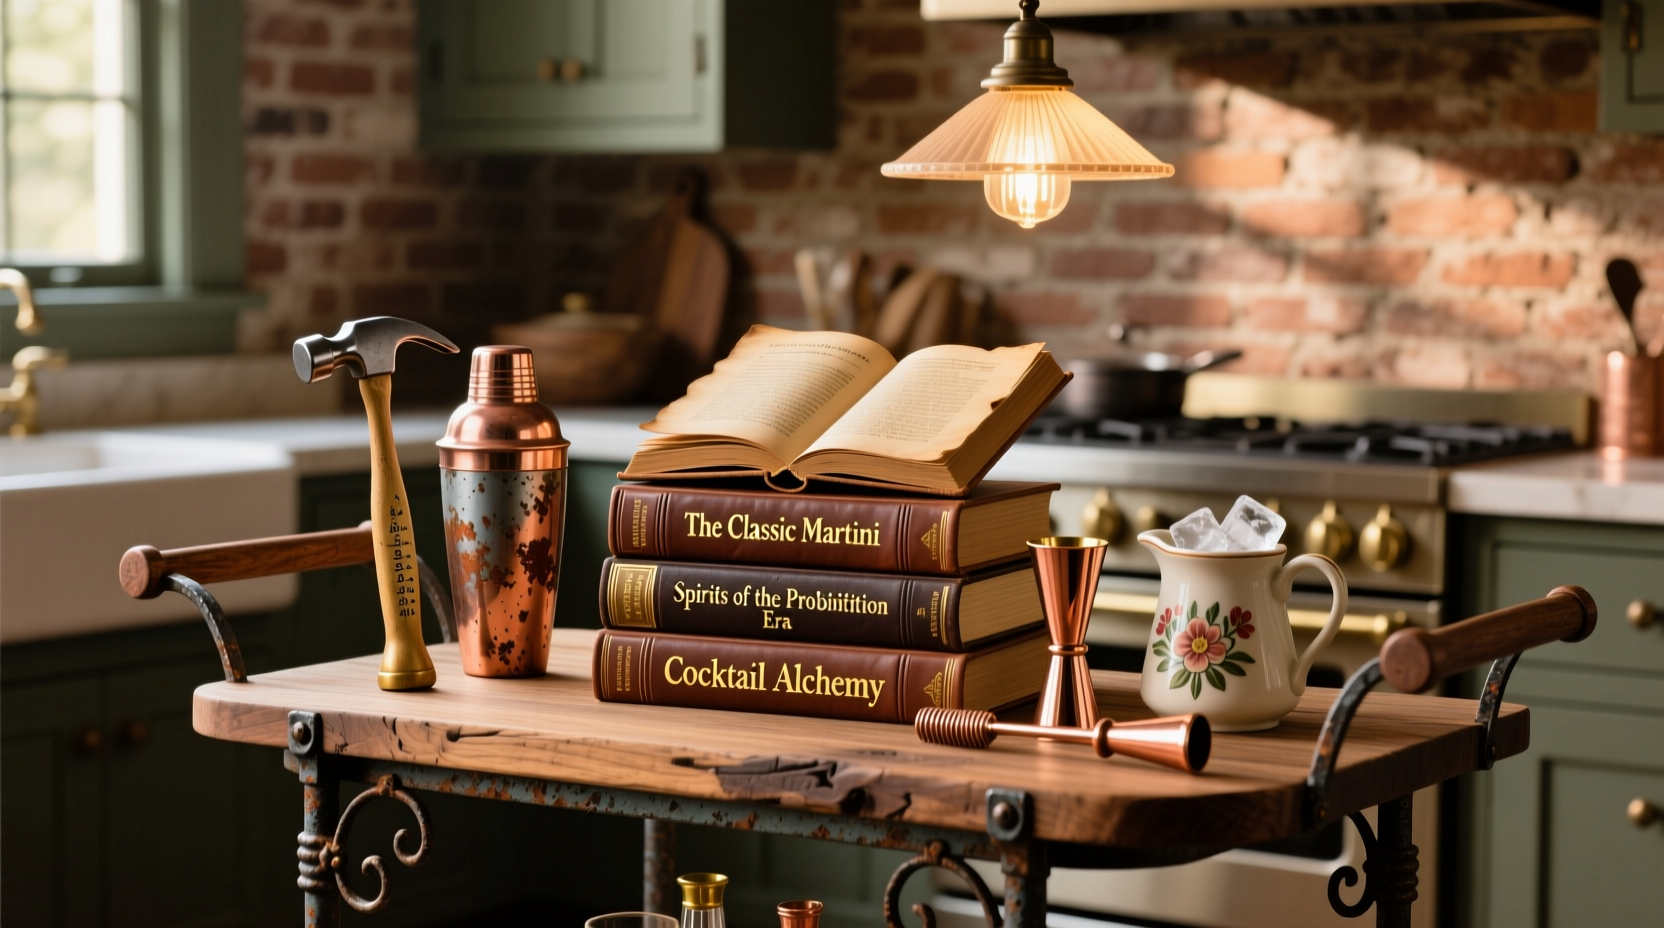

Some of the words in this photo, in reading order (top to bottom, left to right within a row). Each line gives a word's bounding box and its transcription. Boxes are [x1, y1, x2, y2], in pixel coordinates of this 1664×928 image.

[683, 511, 723, 539] The
[727, 513, 797, 542] Classic
[801, 516, 881, 547] Martini
[673, 580, 729, 611] Spirits
[732, 585, 752, 607] of
[755, 586, 782, 608] the
[762, 609, 792, 629] Era
[664, 655, 767, 691] Cocktail
[772, 662, 886, 708] Alchemy
